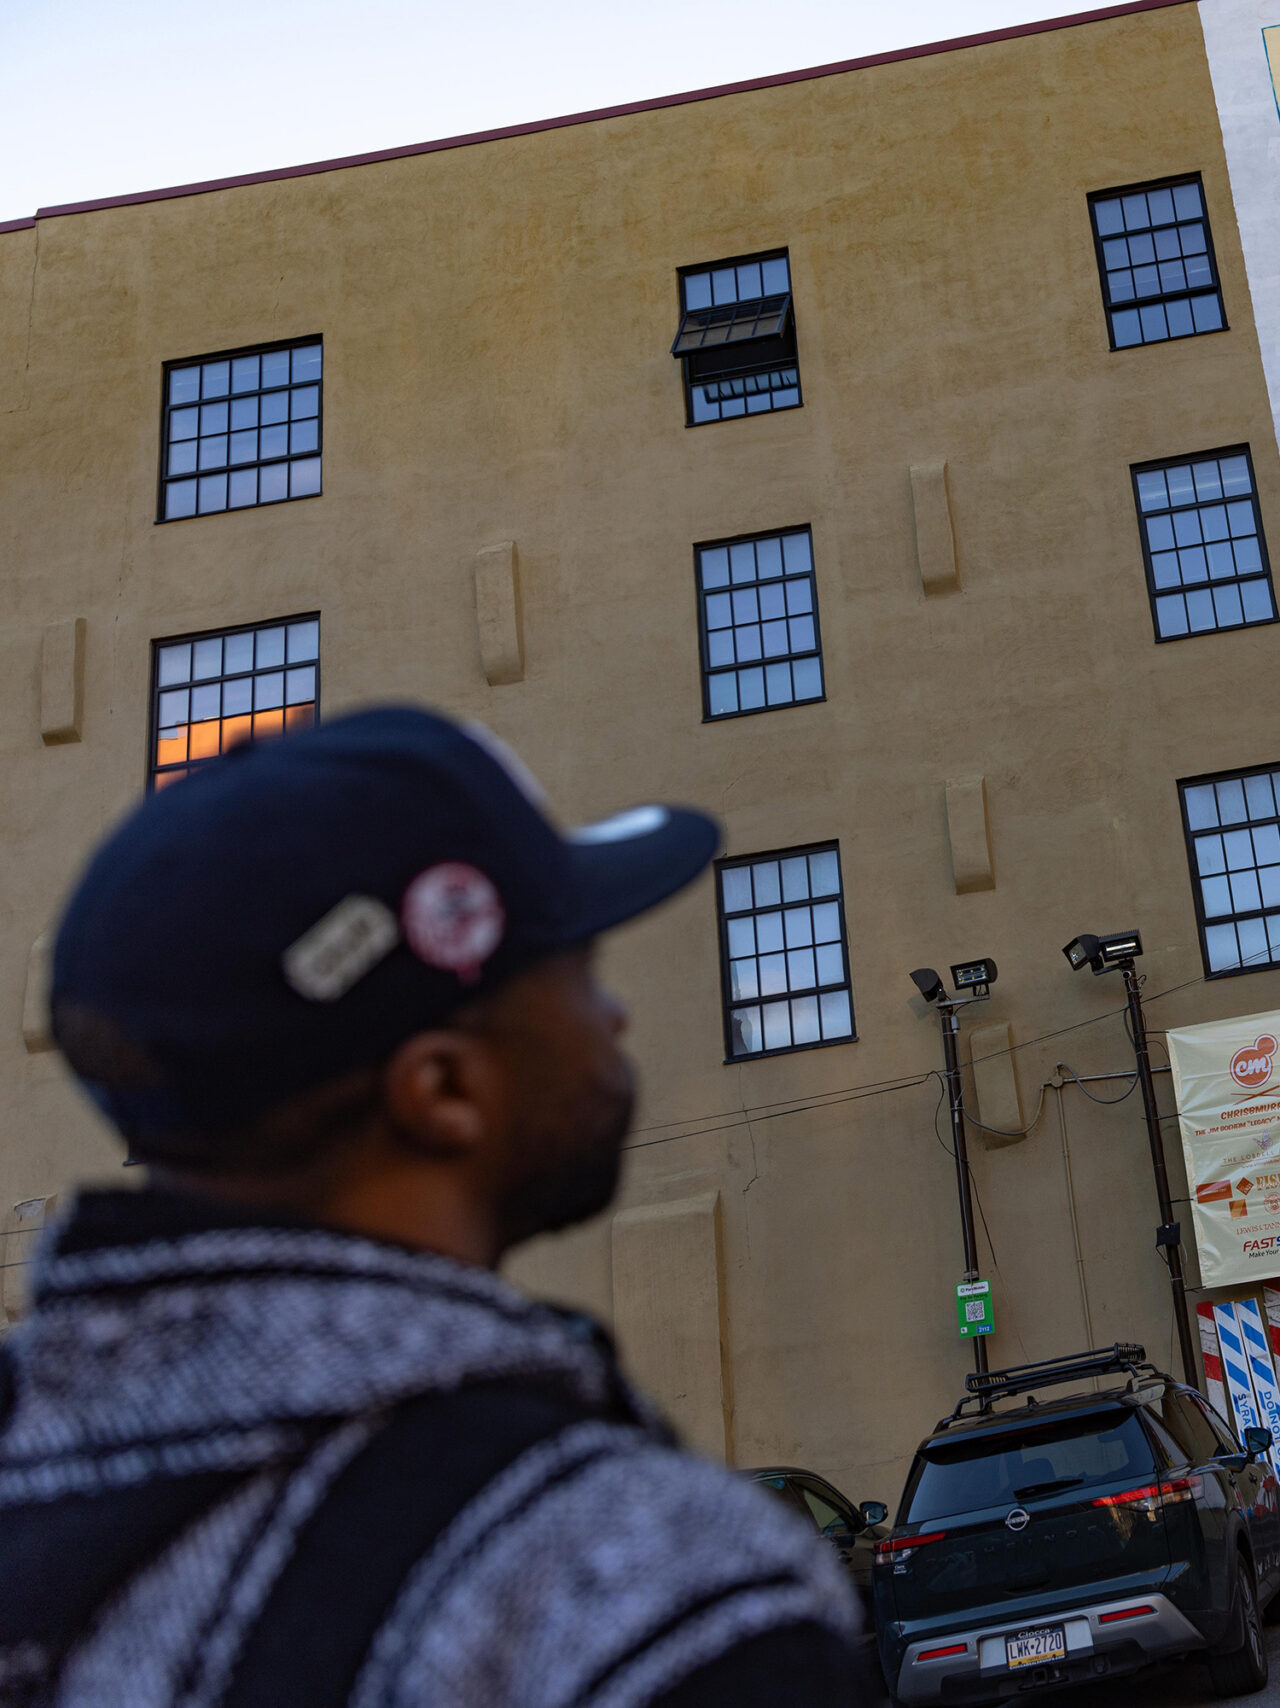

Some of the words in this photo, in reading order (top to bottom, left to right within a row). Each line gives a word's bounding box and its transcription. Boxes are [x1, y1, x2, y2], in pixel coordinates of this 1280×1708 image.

[1248, 1250, 1265, 1259] Make
[1266, 1248, 1279, 1256] Your
[1263, 1390, 1275, 1410] DO
[1237, 1393, 1251, 1429] SYRA
